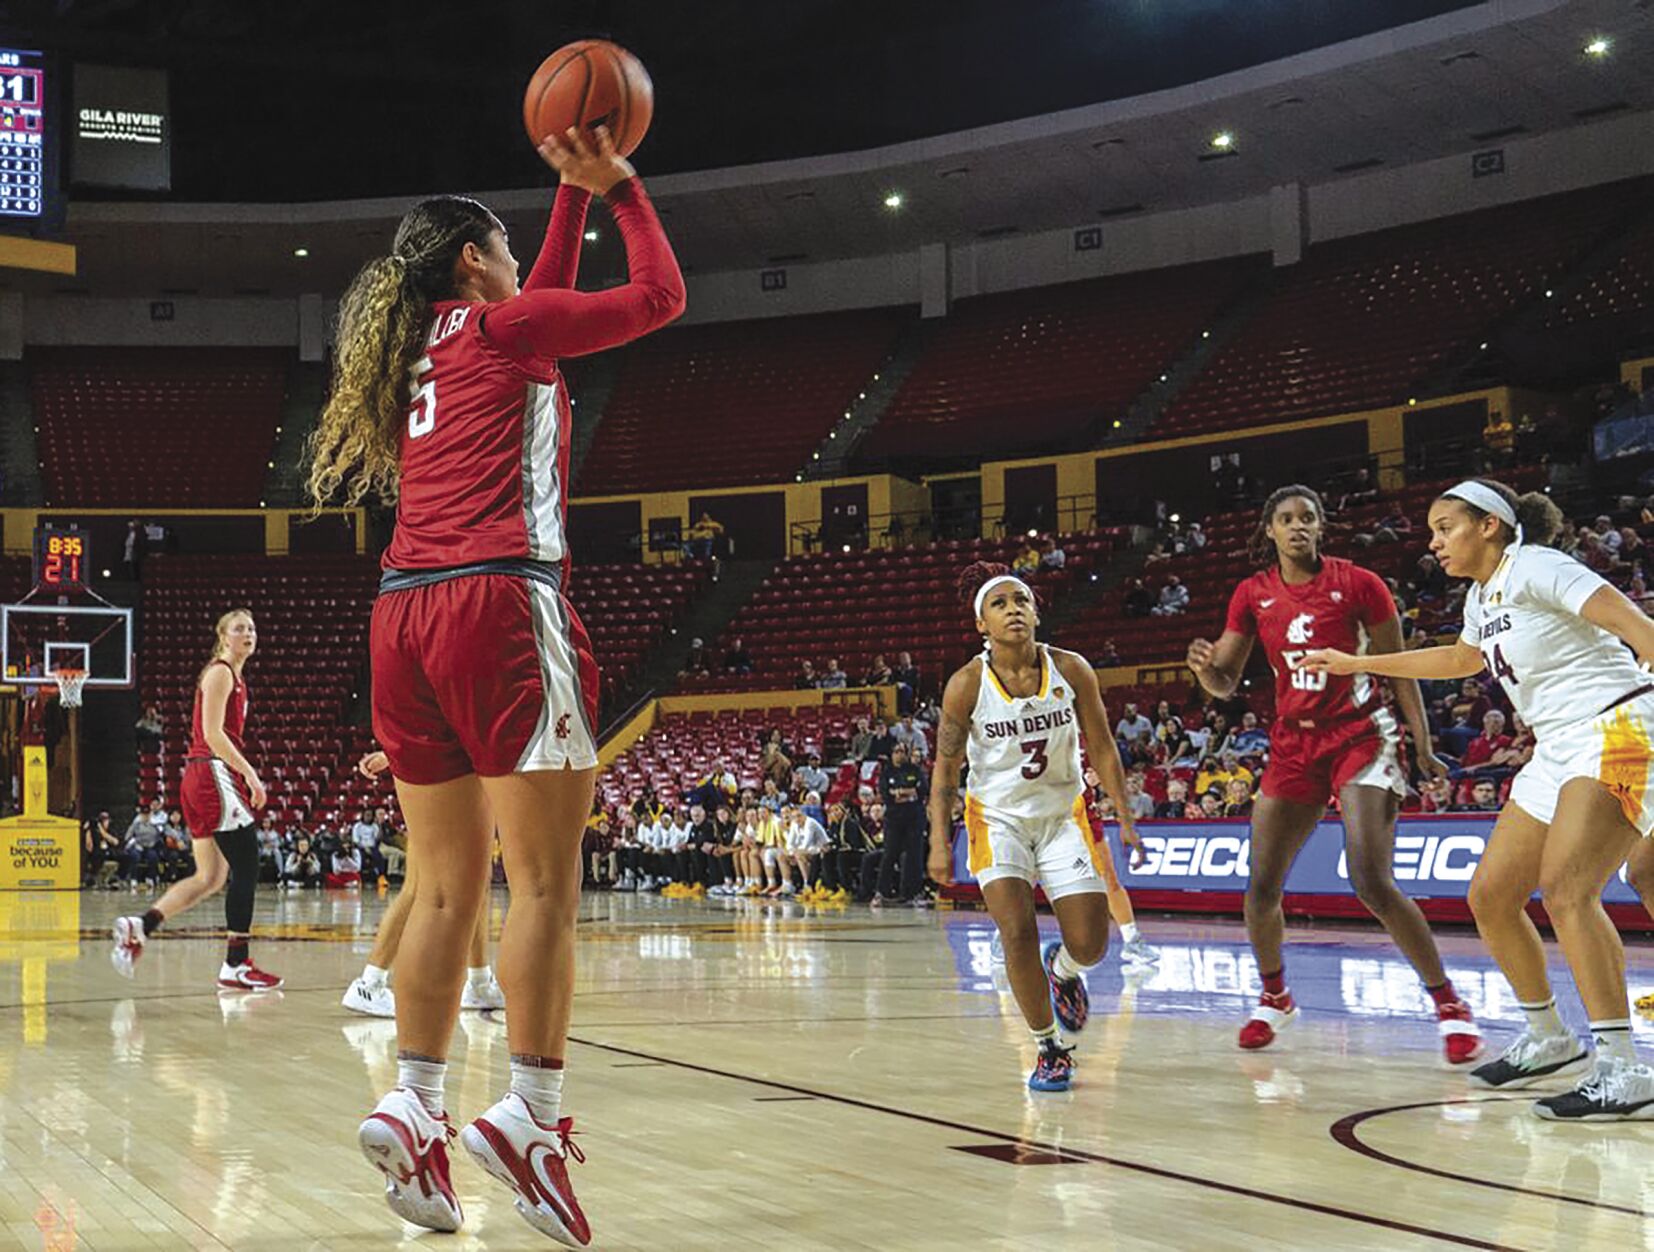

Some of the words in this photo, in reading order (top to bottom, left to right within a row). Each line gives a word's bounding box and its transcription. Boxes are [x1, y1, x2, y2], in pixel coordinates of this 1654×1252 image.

[80, 109, 114, 123] GILA
[116, 112, 160, 126] RIVER
[408, 357, 436, 439] 5
[49, 537, 82, 556] 8:35
[45, 554, 79, 583] 21
[985, 722, 1018, 739] SUN
[1022, 707, 1072, 733] DEVILS
[1020, 738, 1048, 780] 3
[10, 846, 63, 857] because
[13, 856, 26, 868] of
